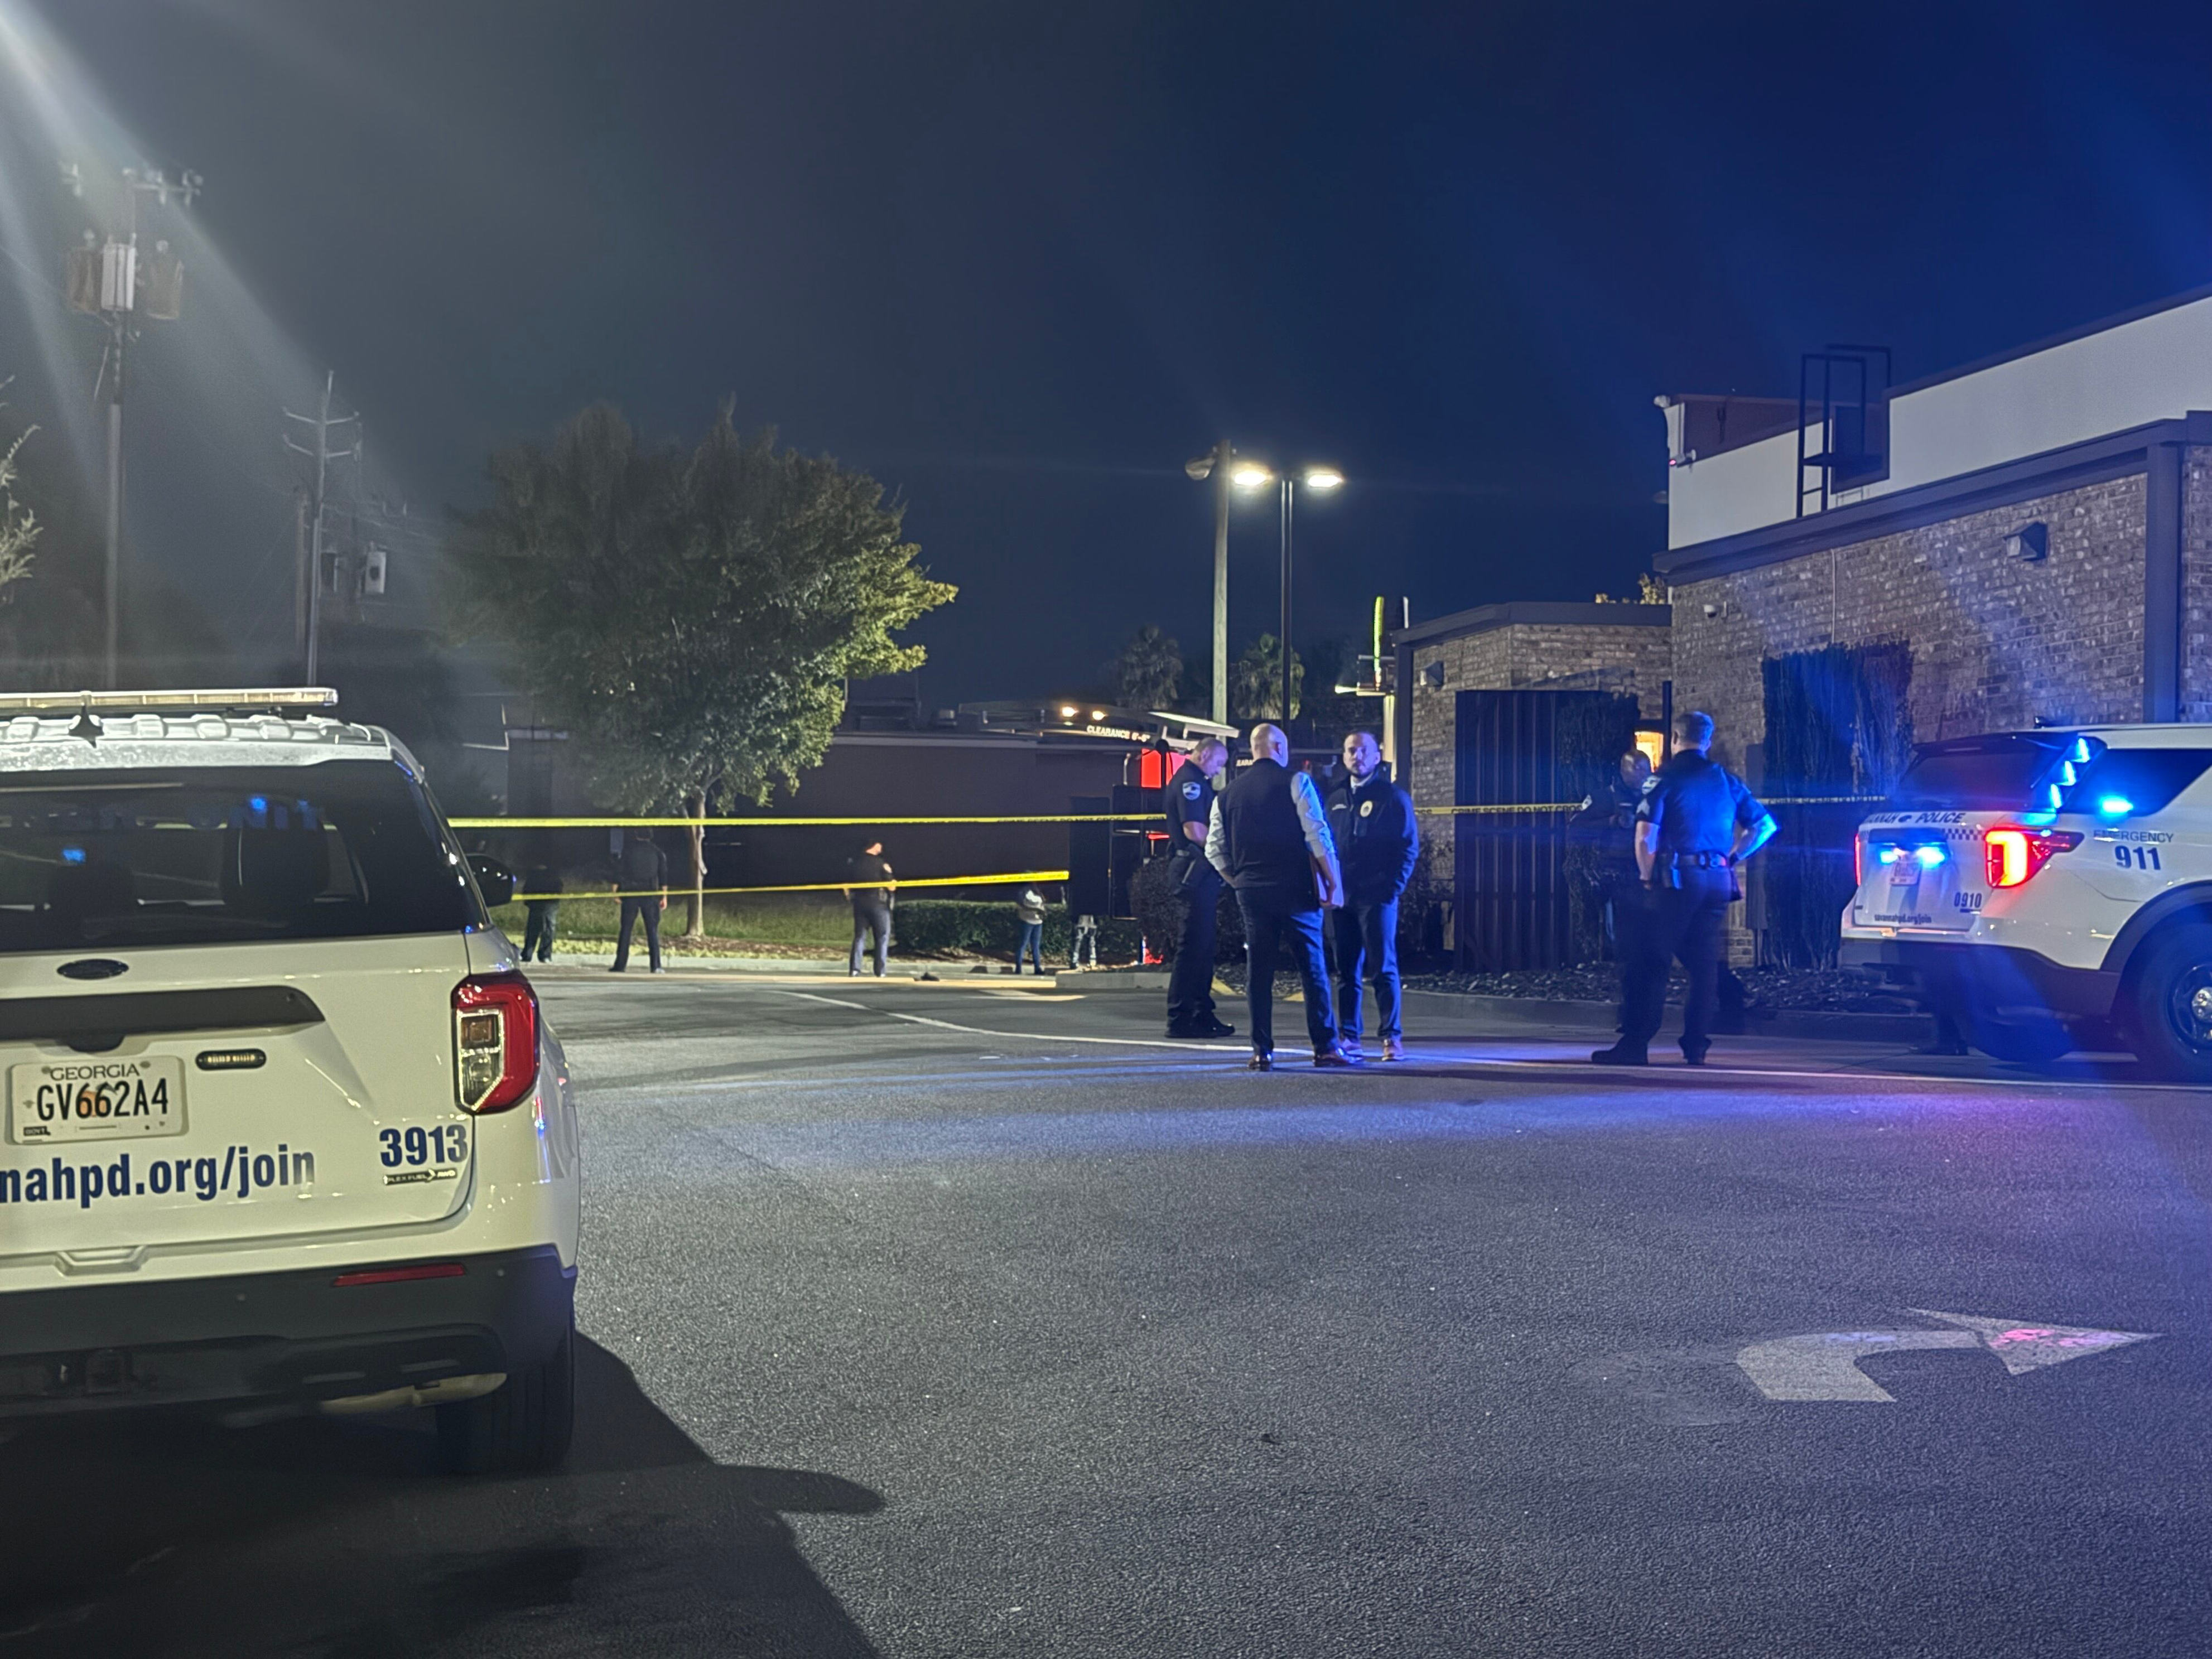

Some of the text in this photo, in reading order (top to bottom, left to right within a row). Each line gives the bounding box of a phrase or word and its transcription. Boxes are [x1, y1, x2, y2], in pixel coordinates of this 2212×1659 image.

[1087, 725, 1130, 739] CLEARANCE
[1915, 812, 1967, 823] POLICE
[2115, 845, 2161, 871] 911
[1954, 892, 1982, 908] 0910
[50, 1063, 140, 1081] GEORGIA
[37, 1077, 168, 1121] GV662A4
[379, 1124, 468, 1168] 3913
[0, 1144, 315, 1209] nahpd.org/join
